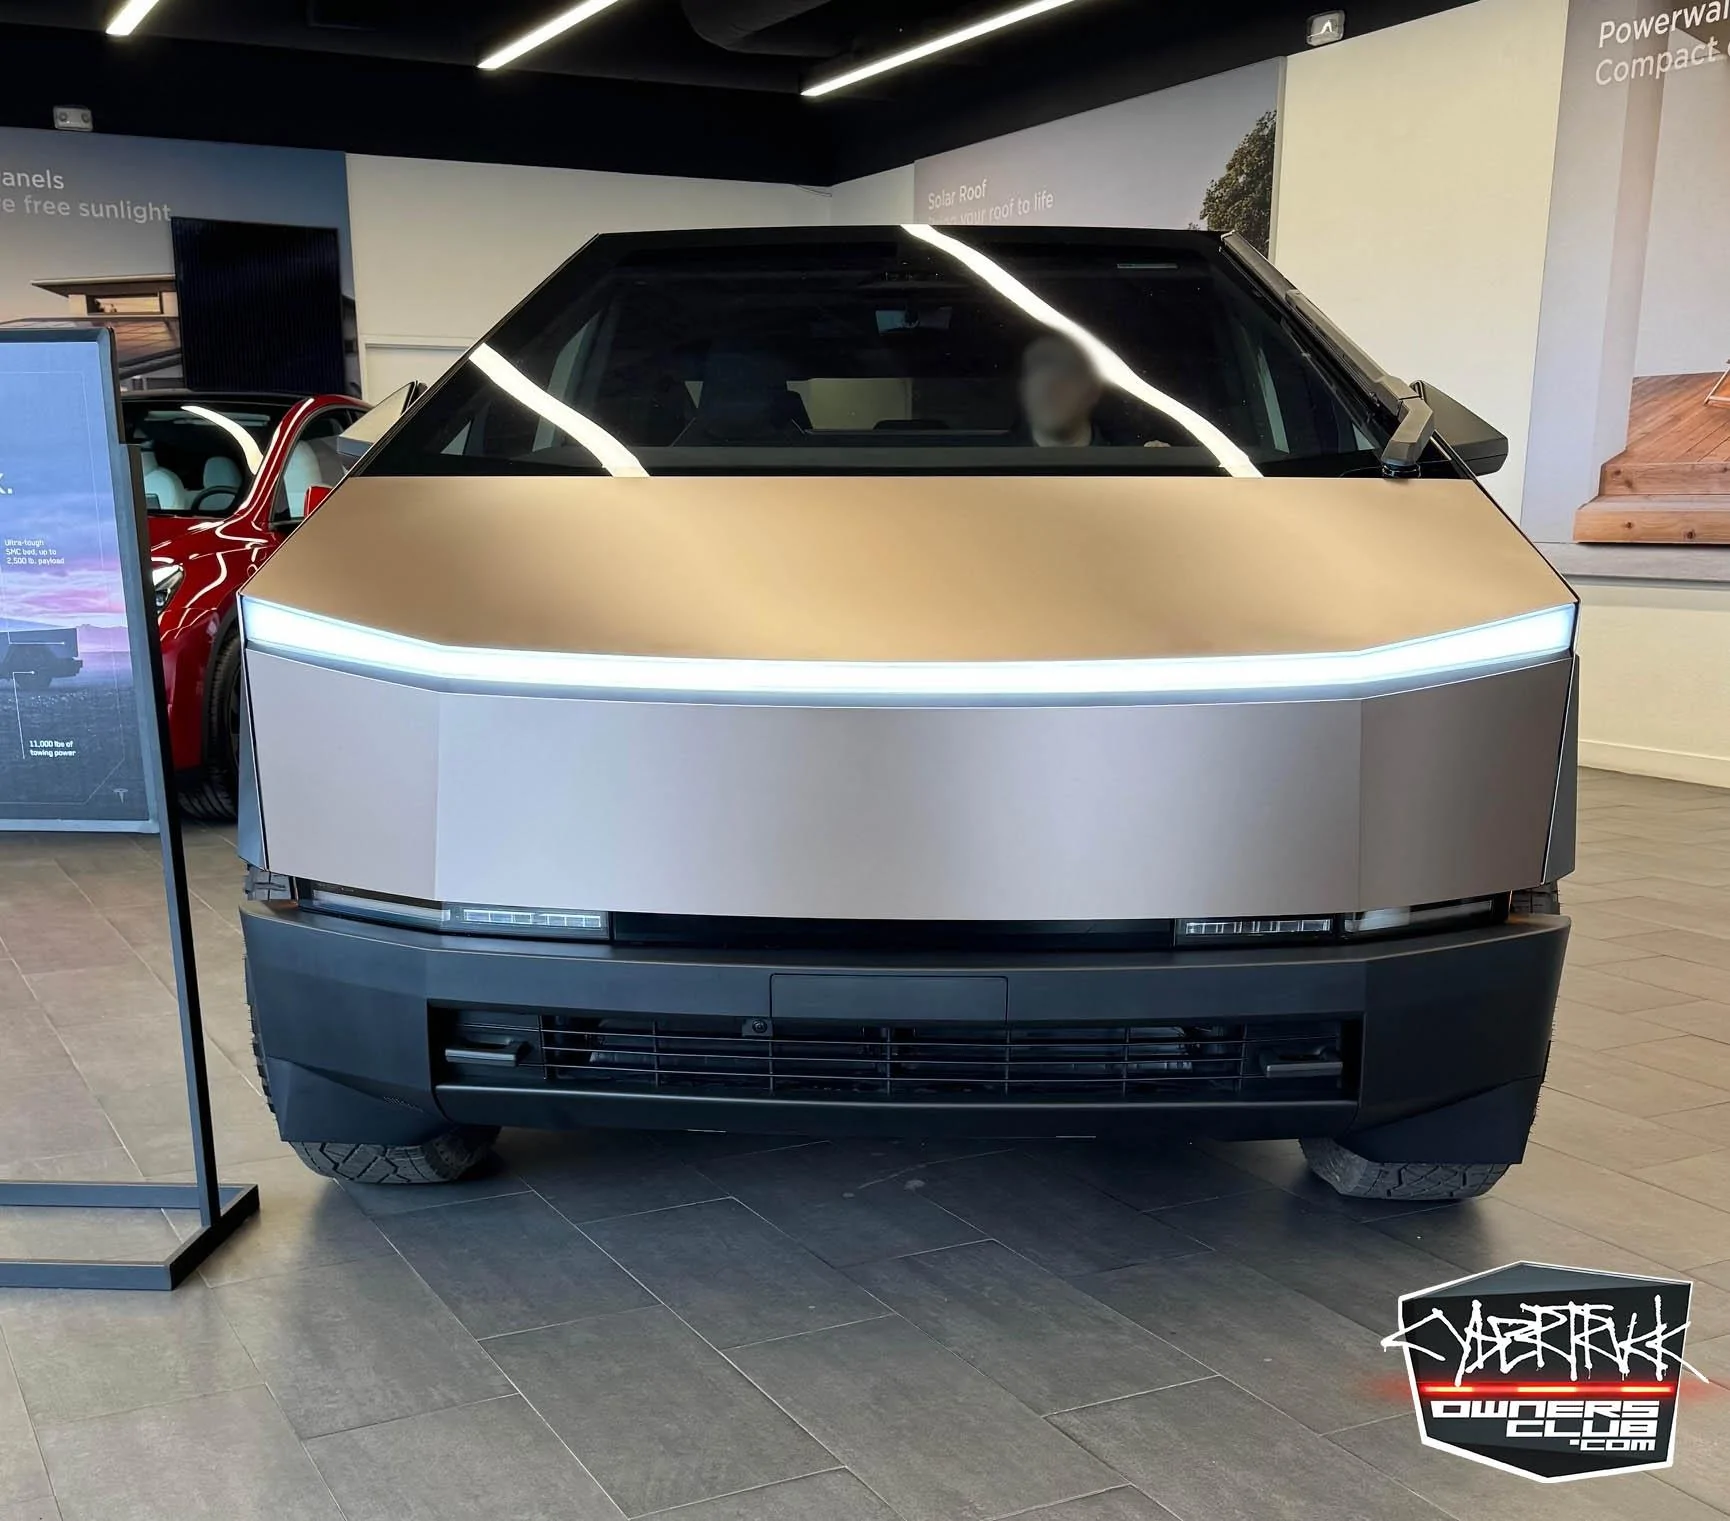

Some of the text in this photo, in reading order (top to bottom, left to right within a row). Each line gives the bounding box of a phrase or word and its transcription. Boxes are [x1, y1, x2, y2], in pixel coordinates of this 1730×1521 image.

[1595, 36, 1718, 85] Compact
[0, 169, 65, 189] anels
[928, 179, 987, 211] Solar Roof
[24, 195, 71, 216] free
[79, 200, 171, 224] sunlight
[960, 208, 987, 225] your
[989, 198, 1015, 221] roof
[1017, 198, 1030, 216] to
[1033, 190, 1054, 212] life
[4, 539, 45, 548] Ultra-tough
[5, 548, 21, 556] SMC
[38, 549, 48, 557] up
[49, 548, 57, 556] to
[6, 557, 27, 565] 2,500
[38, 557, 65, 566] payload
[29, 740, 54, 748] 11,000
[65, 740, 74, 748] of
[29, 749, 77, 758] towing power
